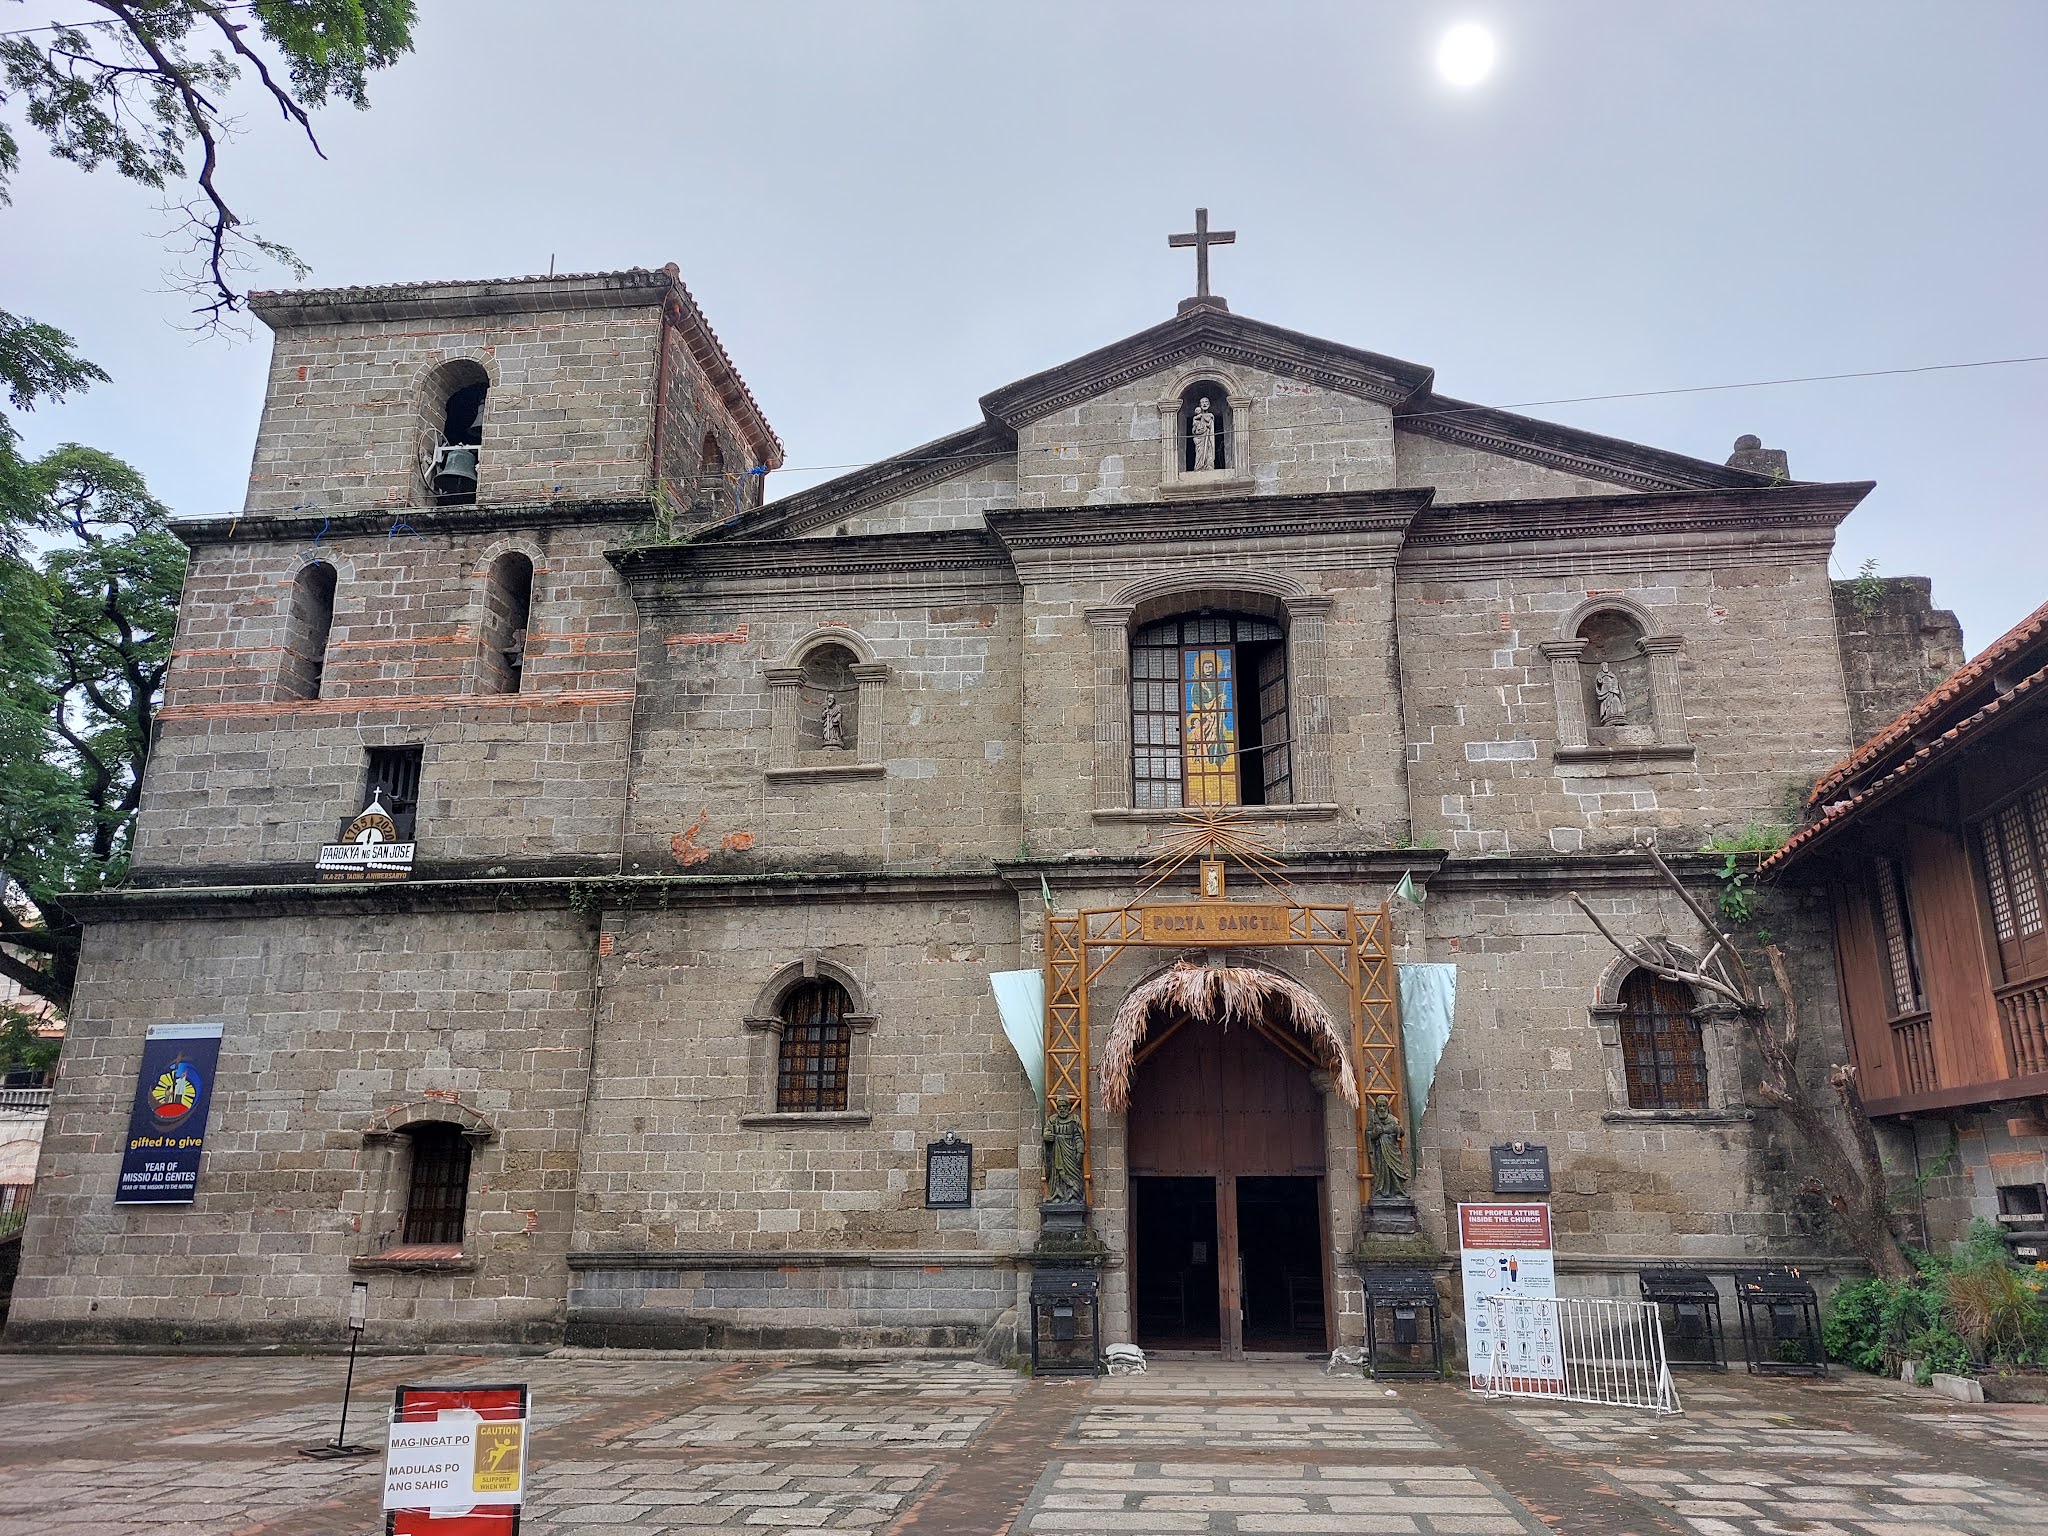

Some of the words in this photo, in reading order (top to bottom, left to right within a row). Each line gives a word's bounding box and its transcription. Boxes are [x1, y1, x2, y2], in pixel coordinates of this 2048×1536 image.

[345, 817, 368, 840] 1795
[375, 816, 395, 841] 2020
[322, 846, 360, 860] PAROKYA
[361, 849, 371, 859] NG
[371, 846, 389, 859] SAN
[389, 845, 411, 859] JOSE
[1153, 915, 1205, 931] PORTA
[1218, 915, 1280, 931] SANCTA
[131, 1136, 163, 1150] gifted
[165, 1137, 176, 1147] to
[178, 1136, 202, 1149] give
[145, 1162, 166, 1172] YEAR
[167, 1162, 178, 1172] OF
[122, 1172, 151, 1183] MISSIO
[151, 1172, 164, 1182] AD
[165, 1171, 196, 1182] GENTES
[480, 1426, 518, 1436] CAUTION
[391, 1436, 452, 1448] MAG-INGAT
[455, 1435, 470, 1445] PO
[389, 1464, 442, 1476] MADULAS
[444, 1463, 460, 1473] PO
[387, 1481, 412, 1492] ANG
[414, 1480, 449, 1490] SAHIG
